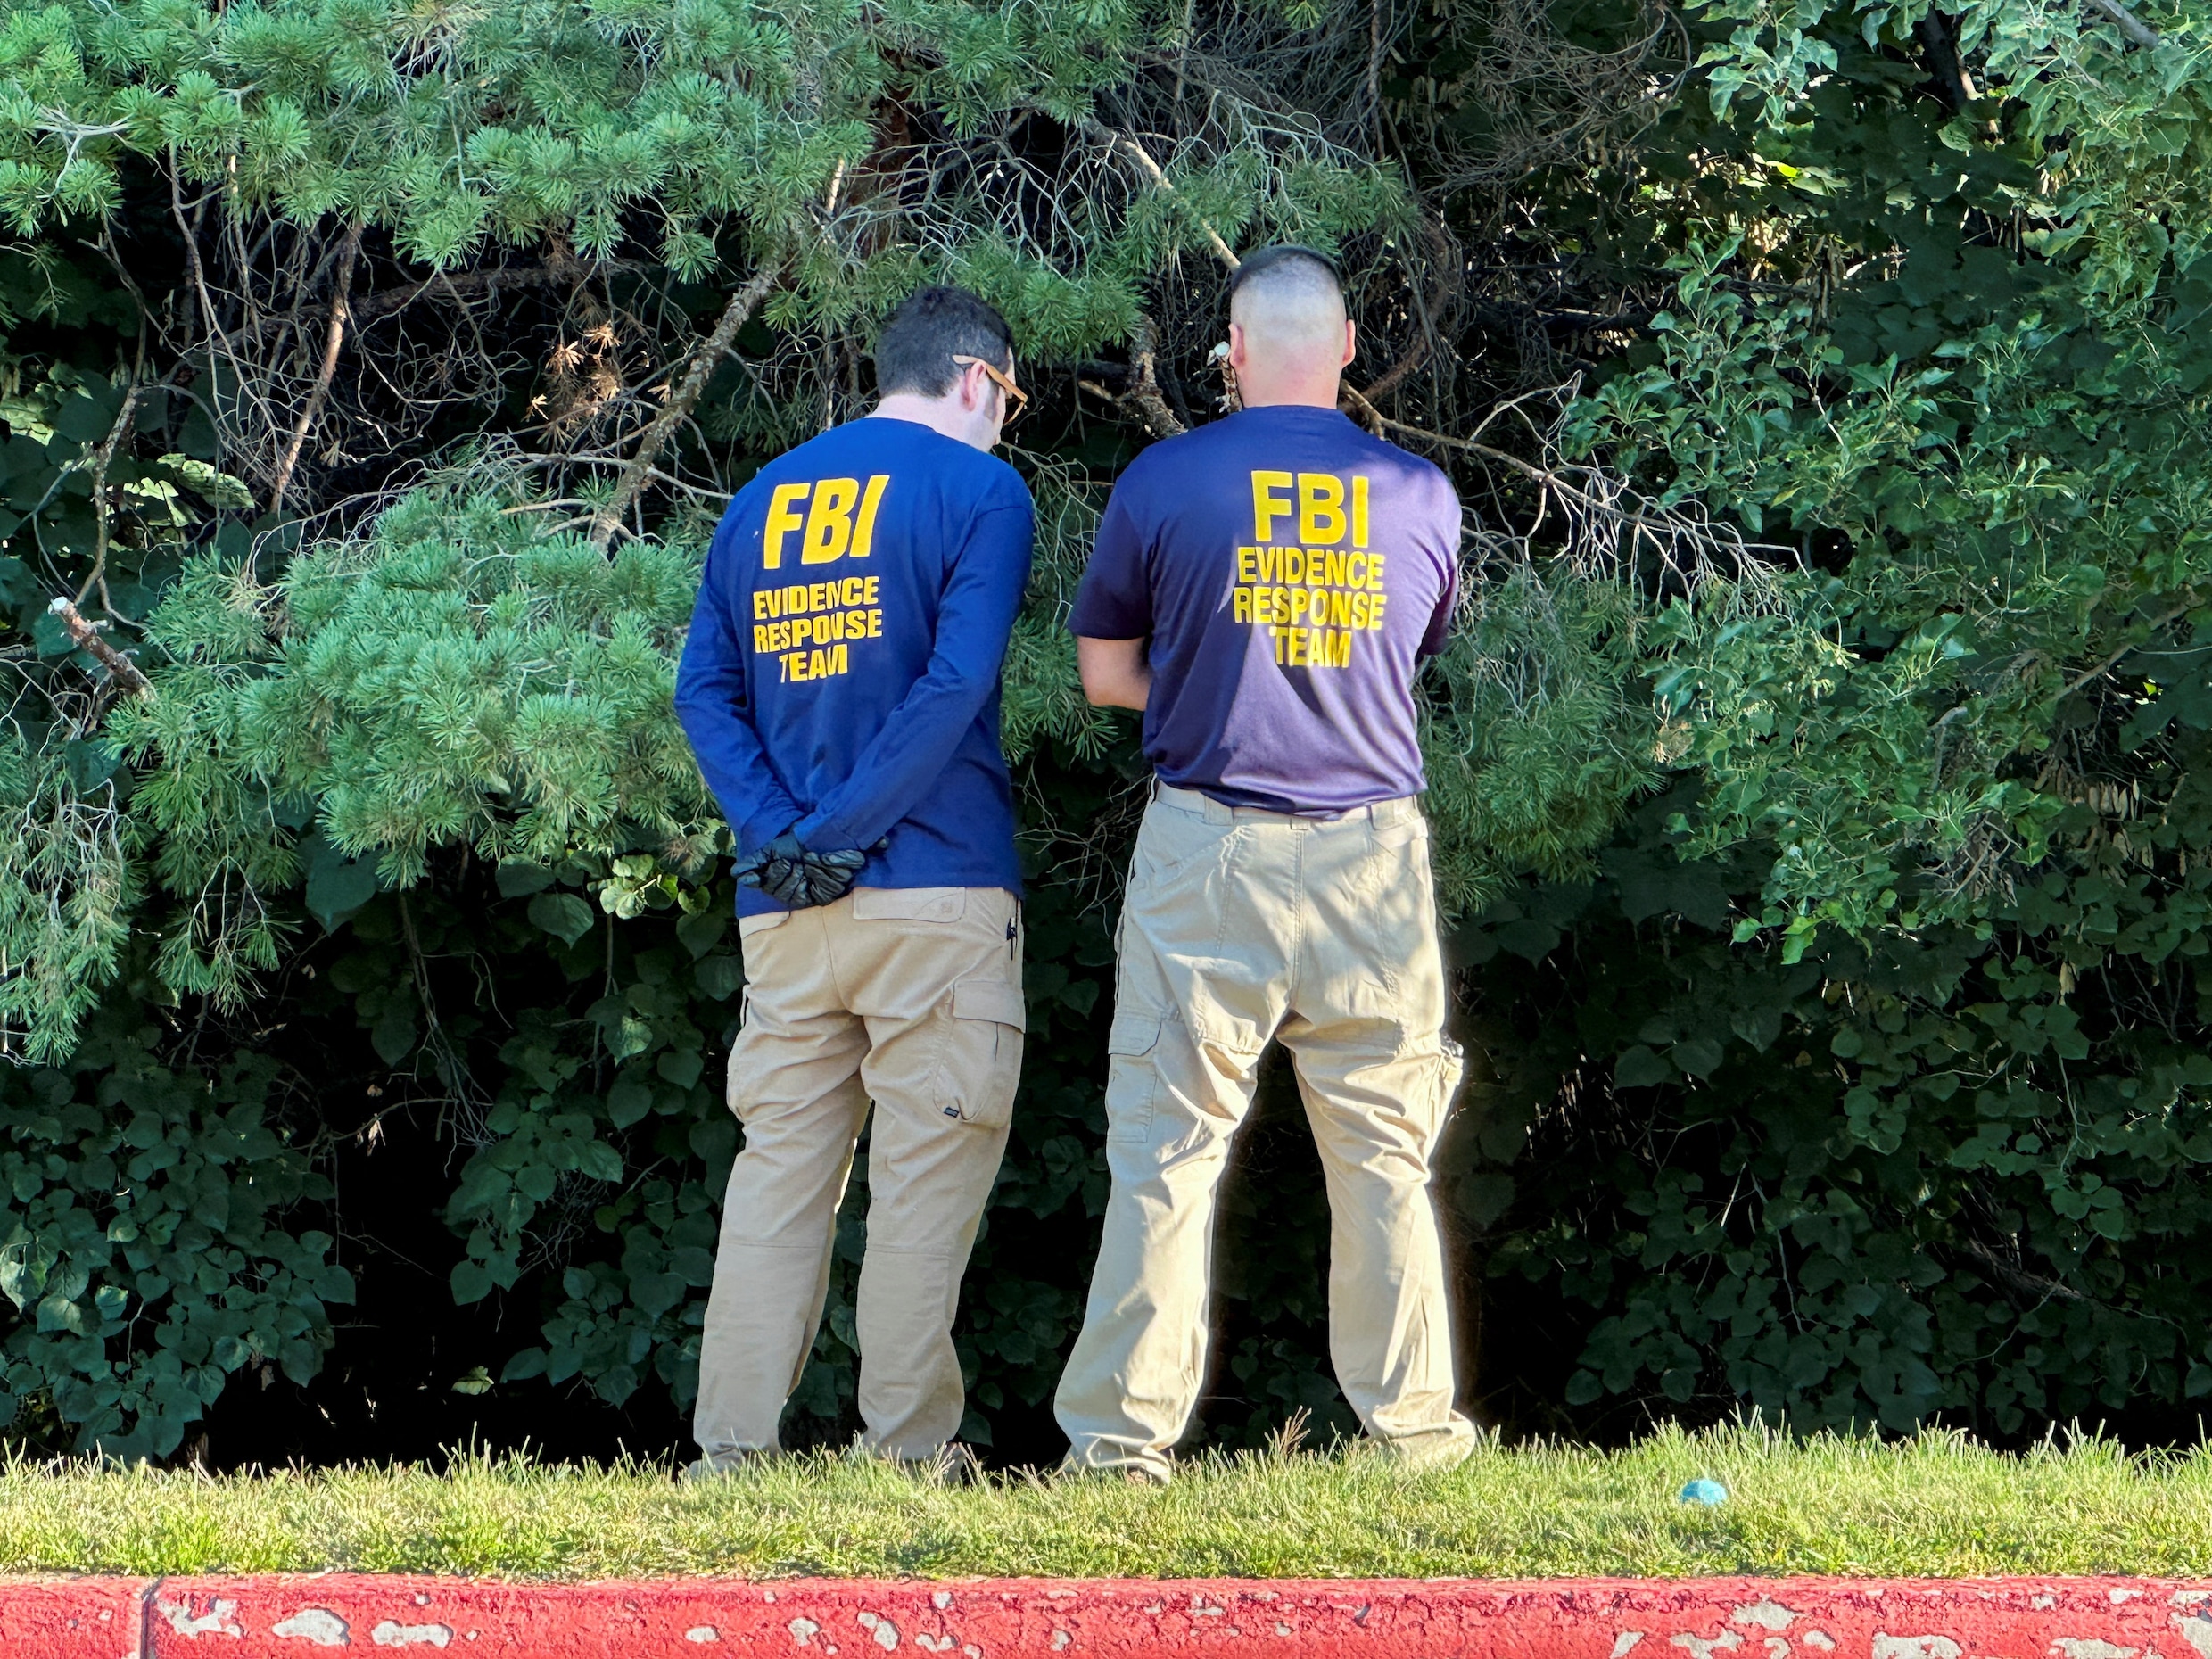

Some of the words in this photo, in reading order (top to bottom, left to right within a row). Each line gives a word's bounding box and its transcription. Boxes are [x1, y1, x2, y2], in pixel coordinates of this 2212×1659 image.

[763, 475, 890, 569] FBI
[1251, 470, 1369, 548] FBI
[1237, 546, 1385, 590] EVIDENCE
[753, 575, 880, 620] EVIDENCE
[1234, 586, 1387, 631] RESPONSE
[753, 608, 883, 654] RESPONSE
[1268, 625, 1352, 668] TEAM
[779, 643, 848, 683] TEAM
